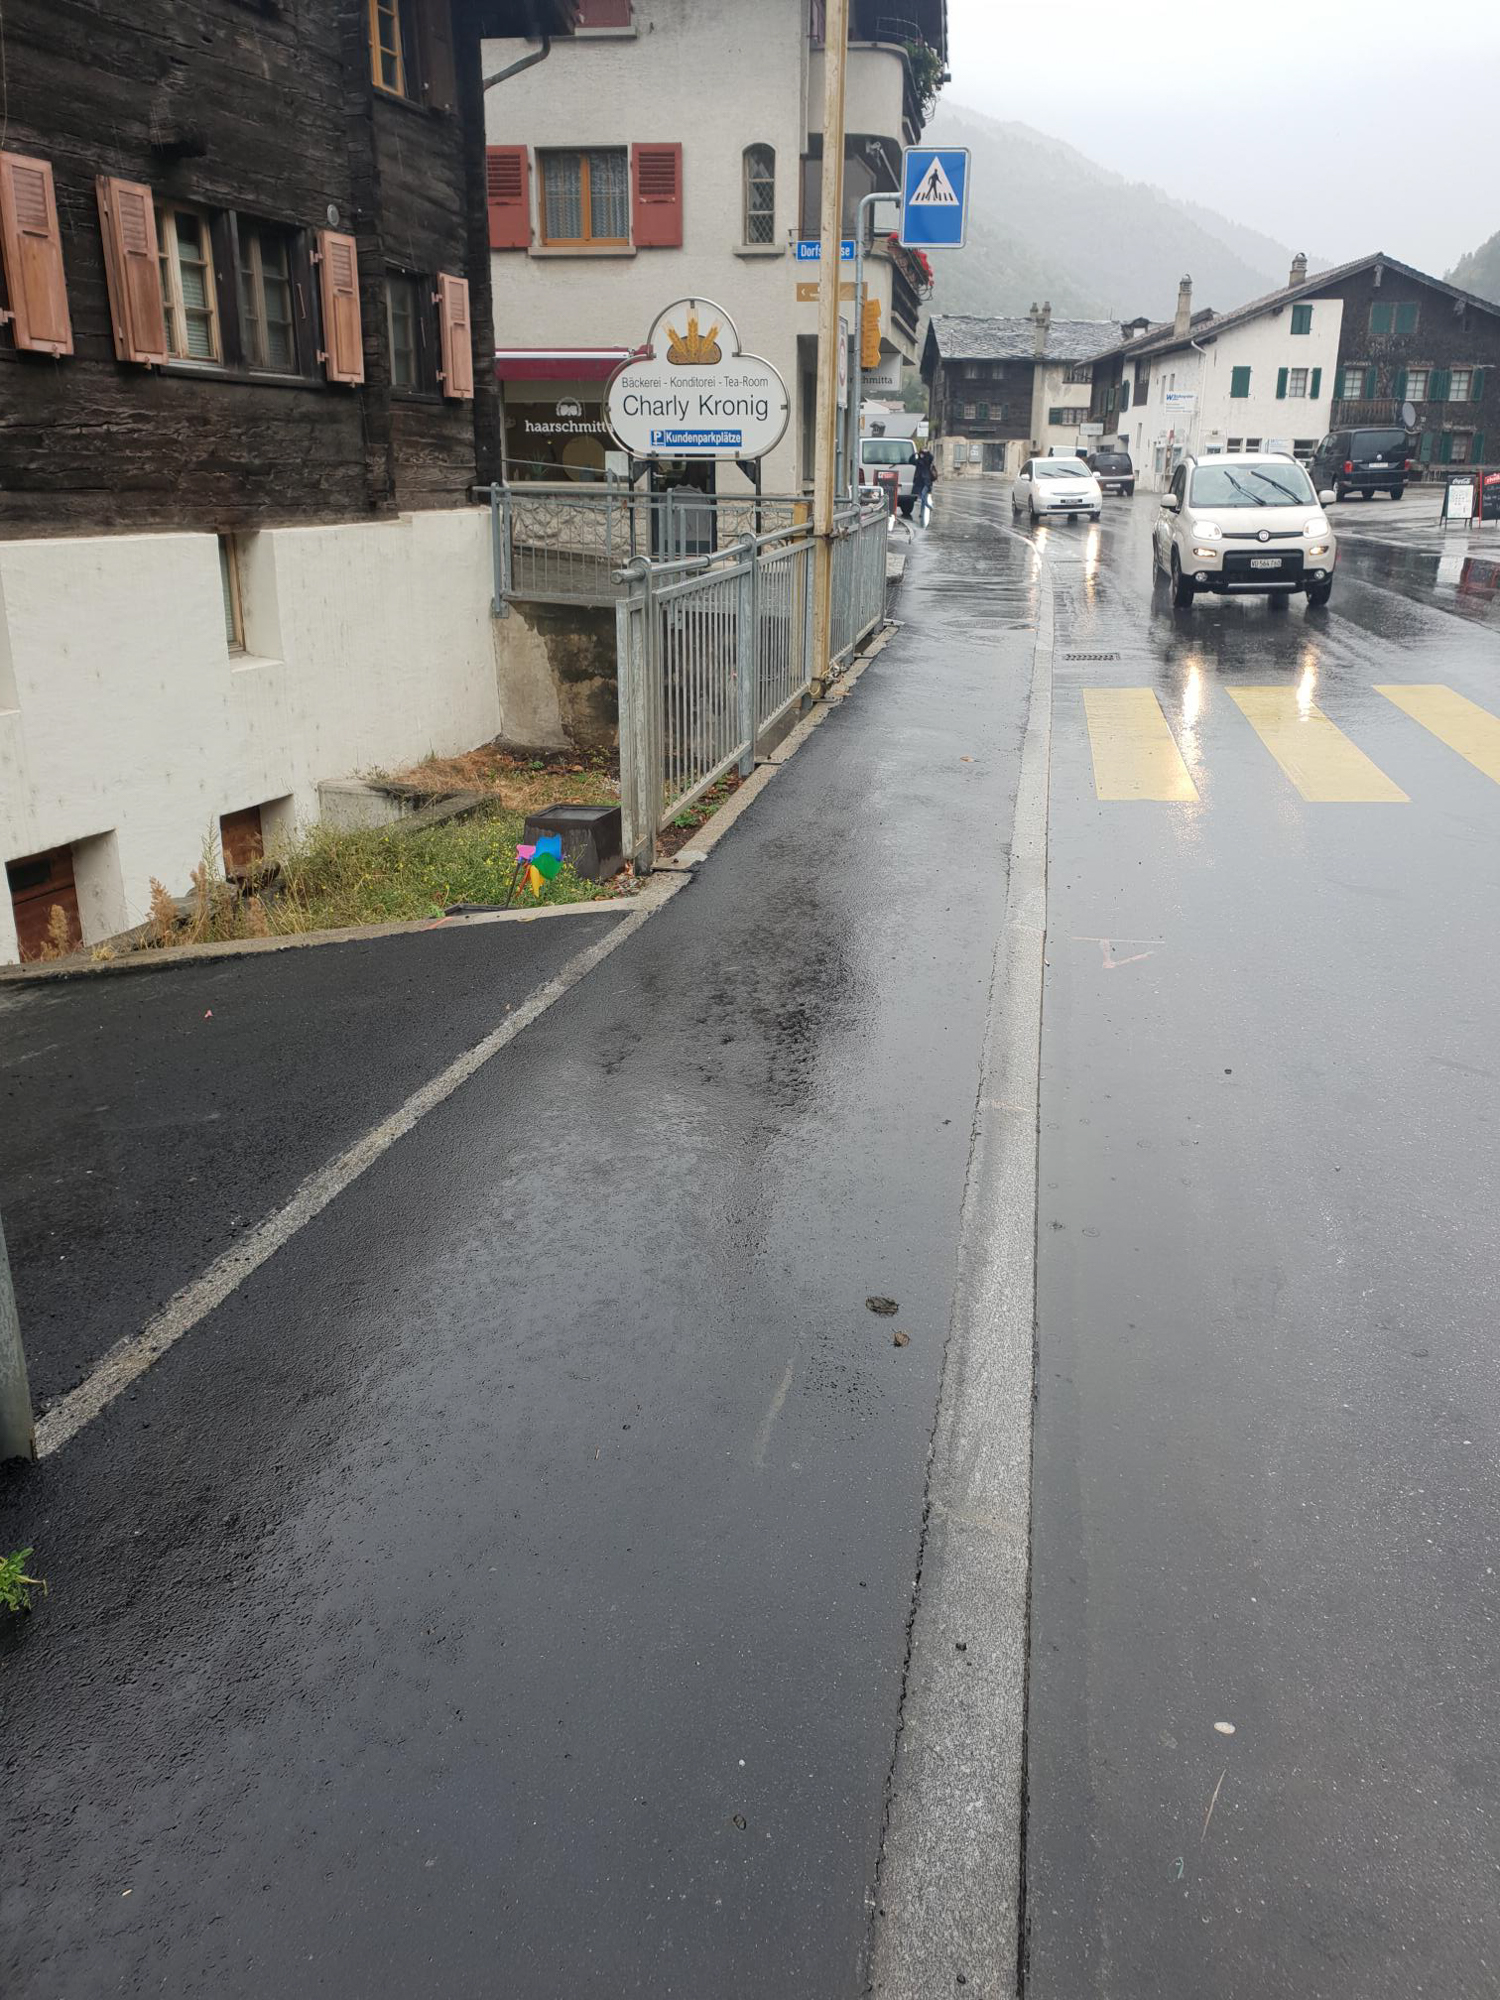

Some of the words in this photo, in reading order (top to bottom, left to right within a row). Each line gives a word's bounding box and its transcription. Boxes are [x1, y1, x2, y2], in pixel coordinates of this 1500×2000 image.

[622, 376, 662, 388] Bäckerei
[670, 376, 716, 388] Konditorei
[723, 375, 769, 387] Tea-Room
[623, 394, 690, 421] Charly
[699, 394, 768, 422] Kronig
[666, 431, 741, 446] Kundenparkplätze
